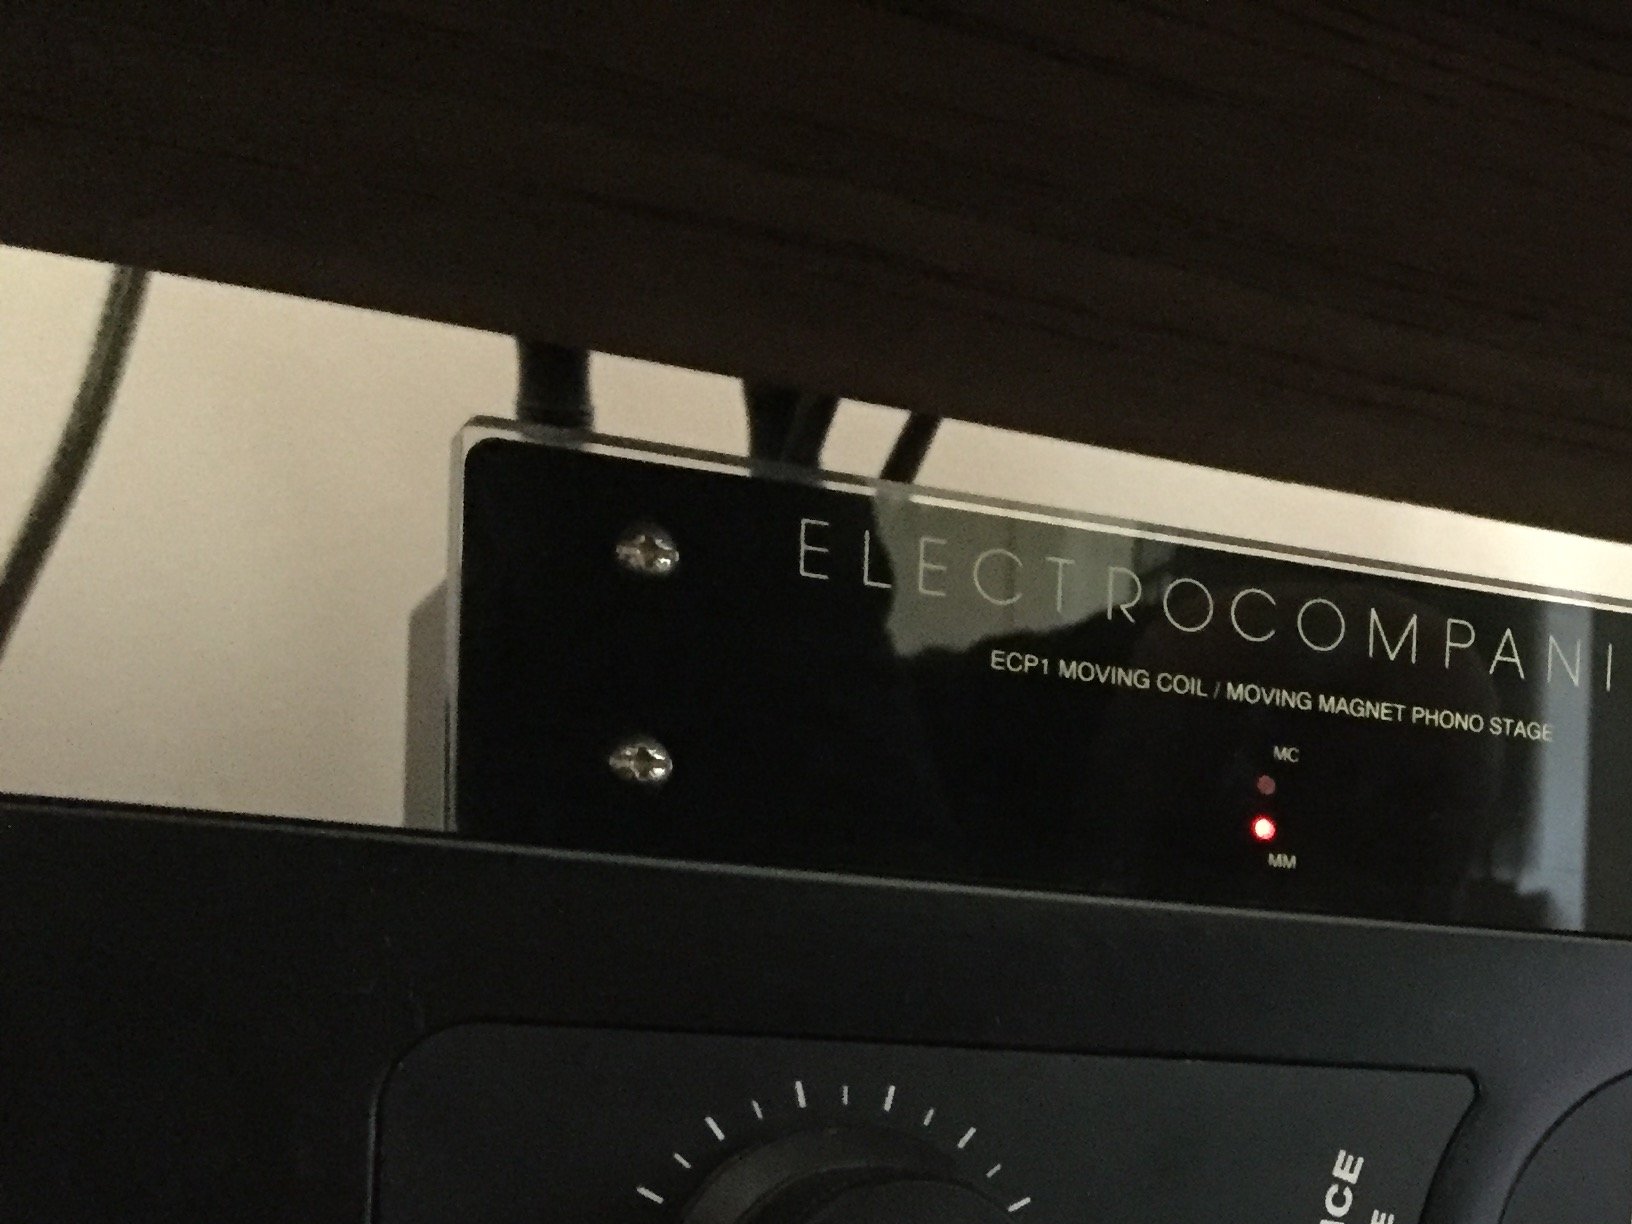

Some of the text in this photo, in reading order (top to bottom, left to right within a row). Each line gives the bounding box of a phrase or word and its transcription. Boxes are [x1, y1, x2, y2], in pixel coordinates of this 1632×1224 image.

[989, 650, 1553, 742] ECP1 MOVING COIL / MOVING MAGNET PHONO STAGE
[1272, 745, 1300, 763] MC
[1267, 852, 1298, 870] MM
